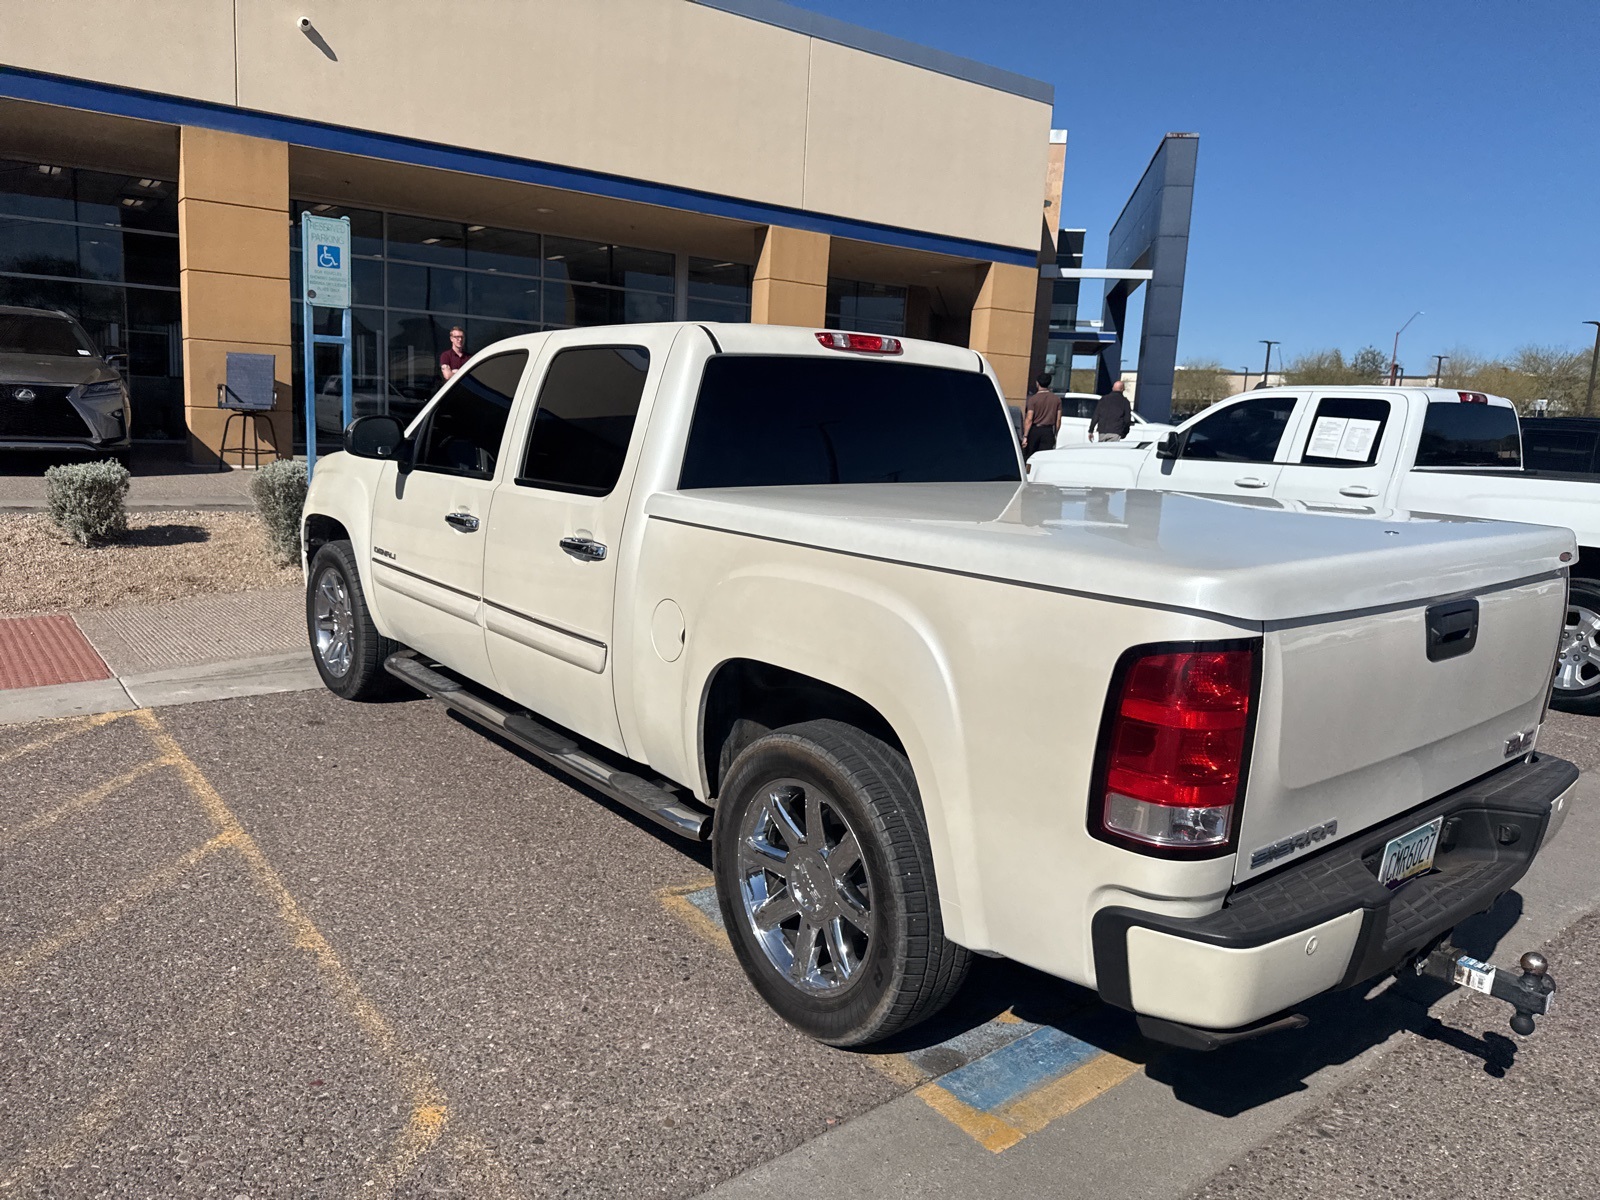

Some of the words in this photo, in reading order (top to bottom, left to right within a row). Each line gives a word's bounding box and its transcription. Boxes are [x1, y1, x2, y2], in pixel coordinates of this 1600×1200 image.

[311, 232, 345, 245] PARKING
[373, 545, 397, 560] DENALI
[1250, 818, 1337, 870] SIERRA
[1385, 832, 1437, 882] CMR6027
